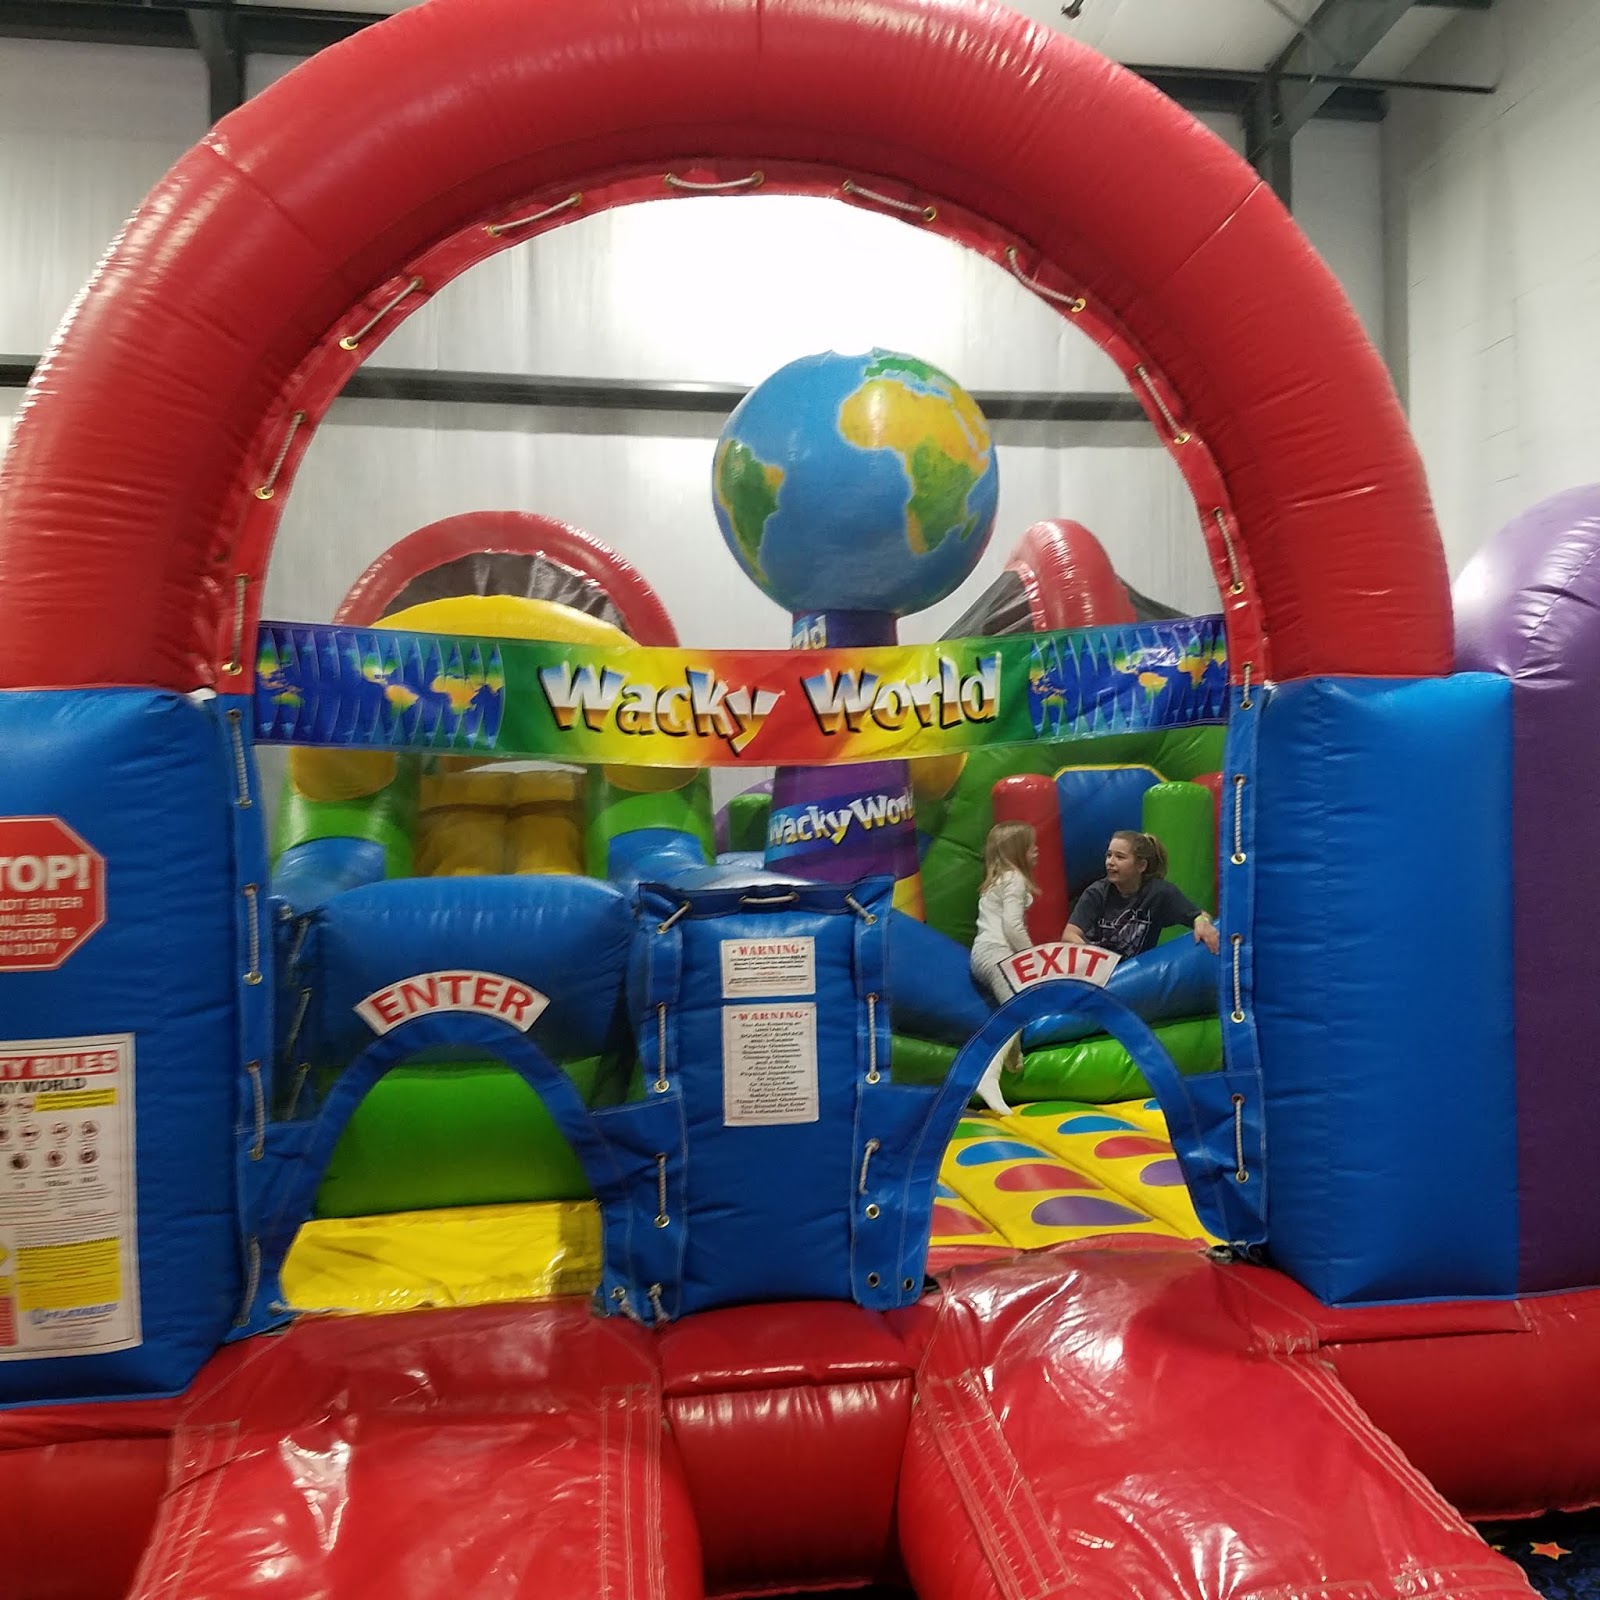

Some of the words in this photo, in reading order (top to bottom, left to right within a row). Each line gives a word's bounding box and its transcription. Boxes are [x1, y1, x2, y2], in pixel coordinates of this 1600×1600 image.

[538, 661, 786, 756] Wacky
[800, 651, 1002, 736] World
[769, 805, 853, 846] Wacky
[26, 896, 84, 910] ENTER
[14, 942, 60, 956] DUTY
[739, 944, 799, 956] WARNING
[1011, 946, 1109, 985] EXIT
[369, 975, 535, 1026] ENTER
[738, 1010, 803, 1021] WARNING
[33, 1053, 118, 1077] RULES
[18, 1077, 88, 1094] WORLD
